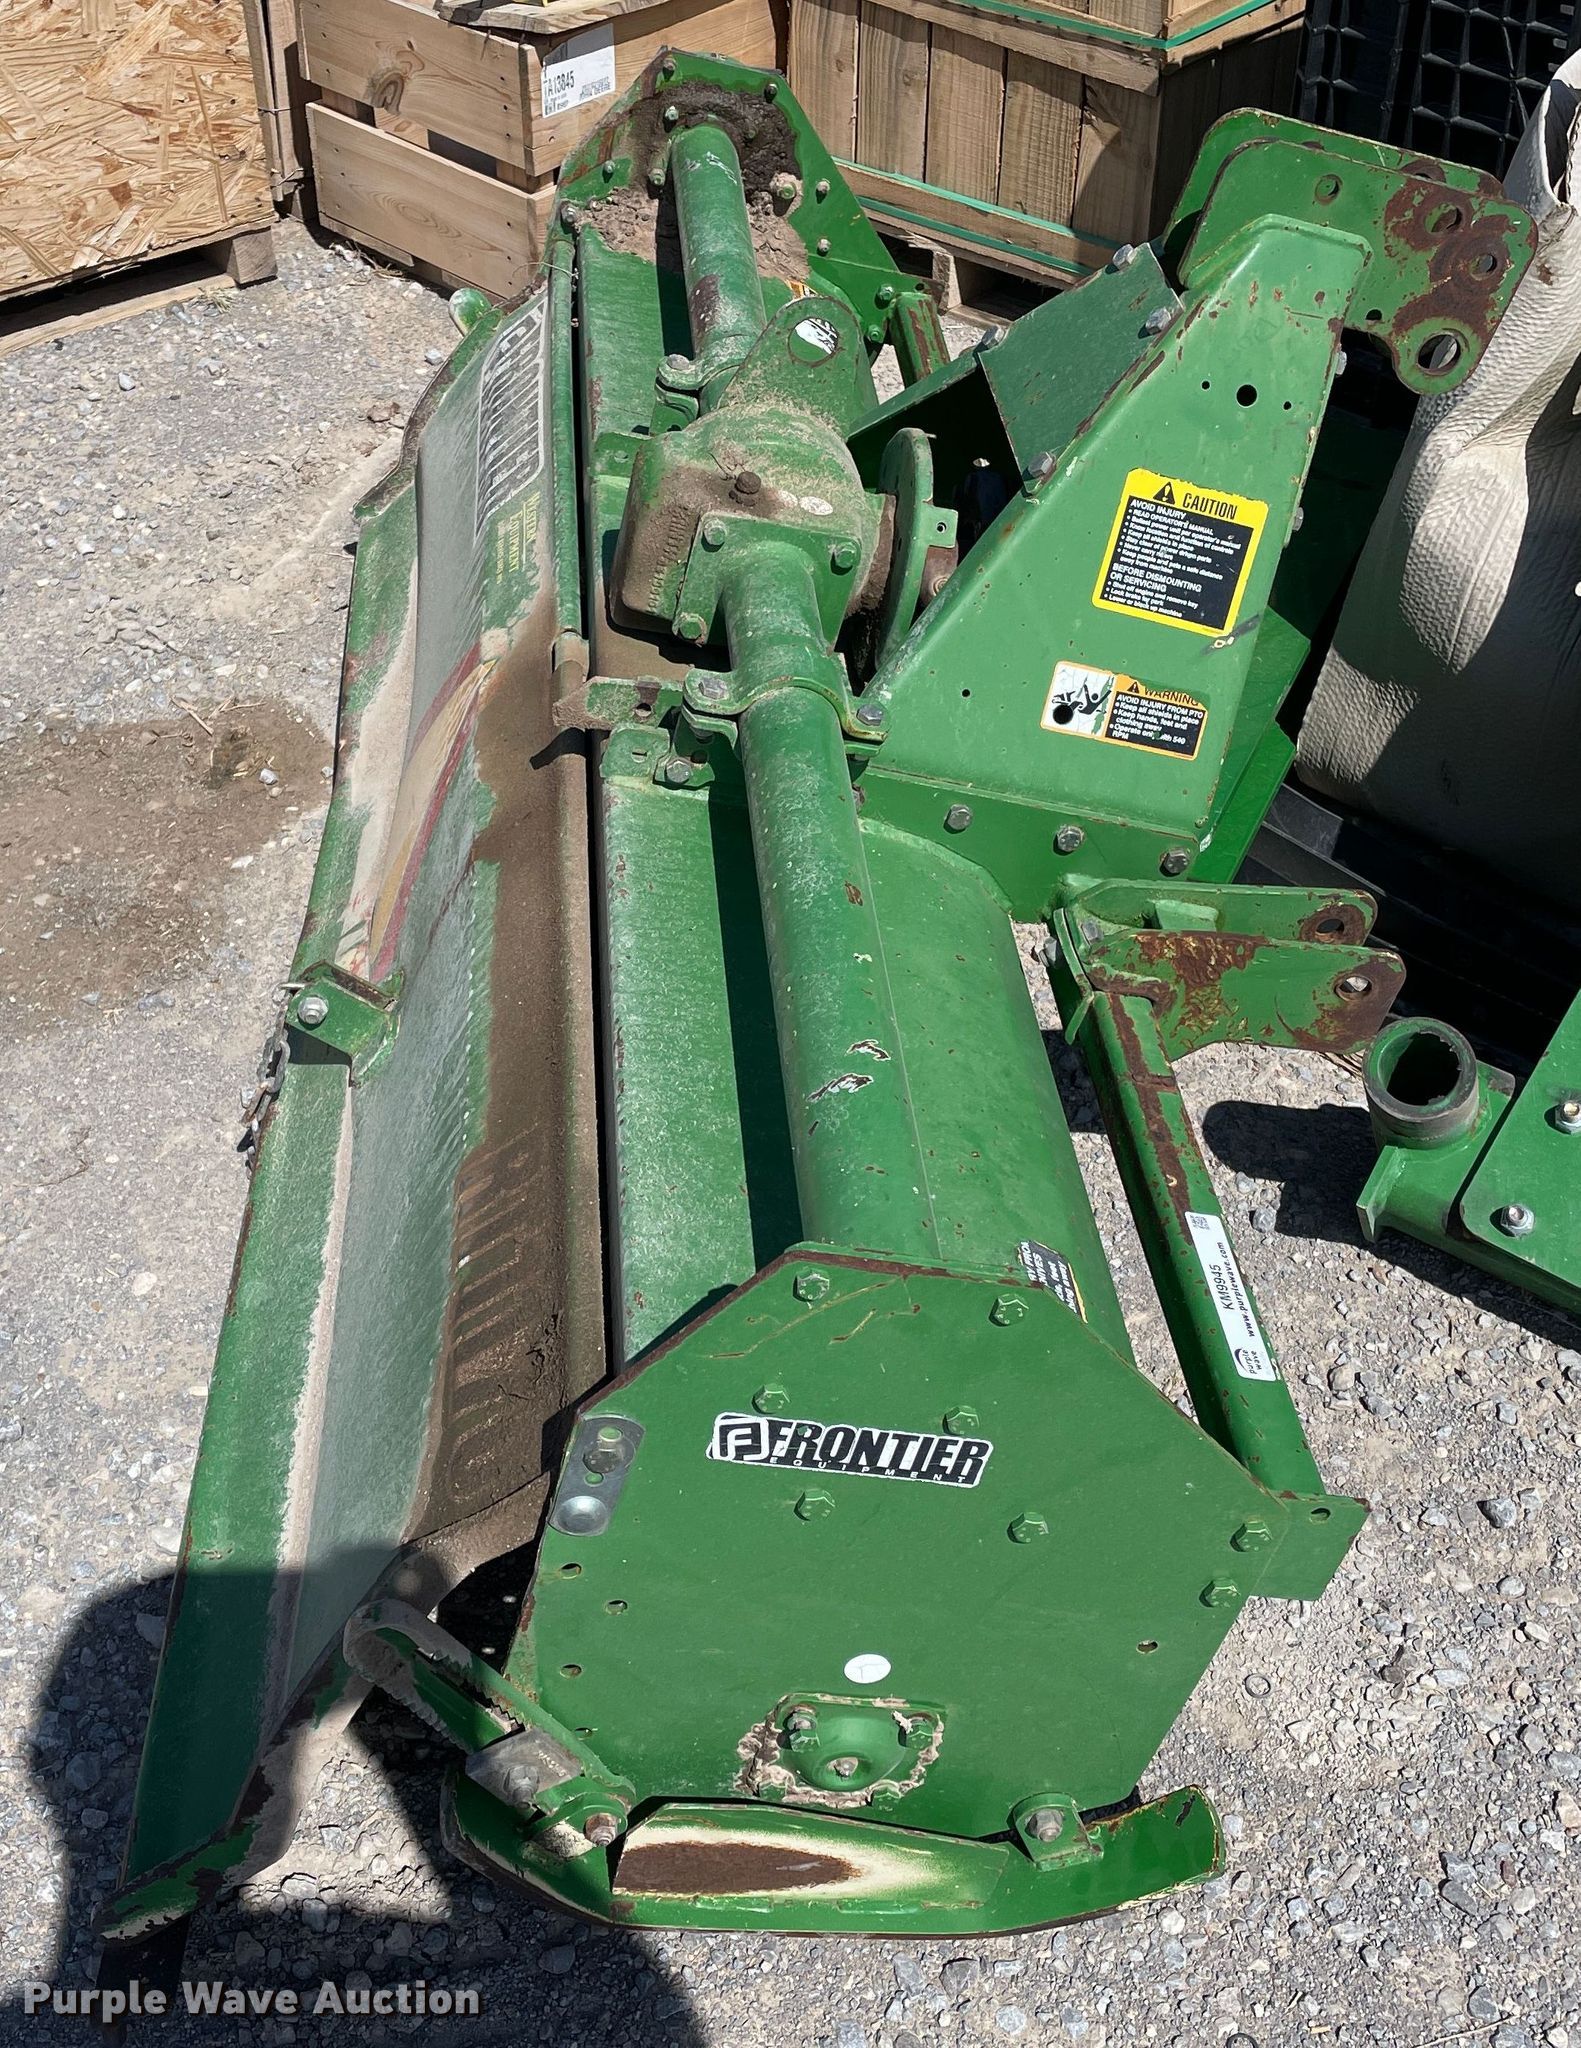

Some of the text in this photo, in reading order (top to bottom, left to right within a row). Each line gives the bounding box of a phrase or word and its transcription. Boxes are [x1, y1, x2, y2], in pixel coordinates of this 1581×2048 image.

[1130, 499, 1186, 520] AVOID INJURY
[1182, 492, 1238, 520] CAUTION
[1133, 509, 1150, 519] READ
[1188, 524, 1214, 535] MANUAL
[1124, 543, 1140, 551] Never
[1140, 548, 1155, 556] carry
[1127, 530, 1142, 539] Keep
[1178, 543, 1194, 552] place
[1139, 540, 1153, 548] clear
[1196, 555, 1212, 564] parts
[1121, 550, 1136, 558] Keep
[1136, 554, 1156, 564] people
[1156, 558, 1168, 566] and
[1199, 569, 1223, 580] distance
[1110, 572, 1167, 592] OR SERVICING
[1112, 563, 1202, 592] BEFORE DISMOUNTING
[1166, 596, 1187, 605] remove
[1117, 693, 1203, 719] AVOID INJURY FROM PTO
[1120, 702, 1138, 713] Keep
[1148, 708, 1172, 719] shields
[1180, 715, 1199, 726] place
[1116, 716, 1162, 732] clothing away
[1118, 709, 1188, 730] Keep hands, feet and
[1112, 730, 1129, 740] RPM
[1114, 723, 1141, 736] Operate
[1159, 733, 1172, 742] ith
[1172, 736, 1186, 745] 540
[1209, 1264, 1234, 1310] KM9945
[1217, 1242, 1255, 1338] www.purplewave.com
[1242, 1349, 1257, 1374] purple
[1251, 1350, 1262, 1370] wave
[767, 1419, 990, 1485] FRONTIER
[769, 1456, 967, 1484] EQUIPMENT
